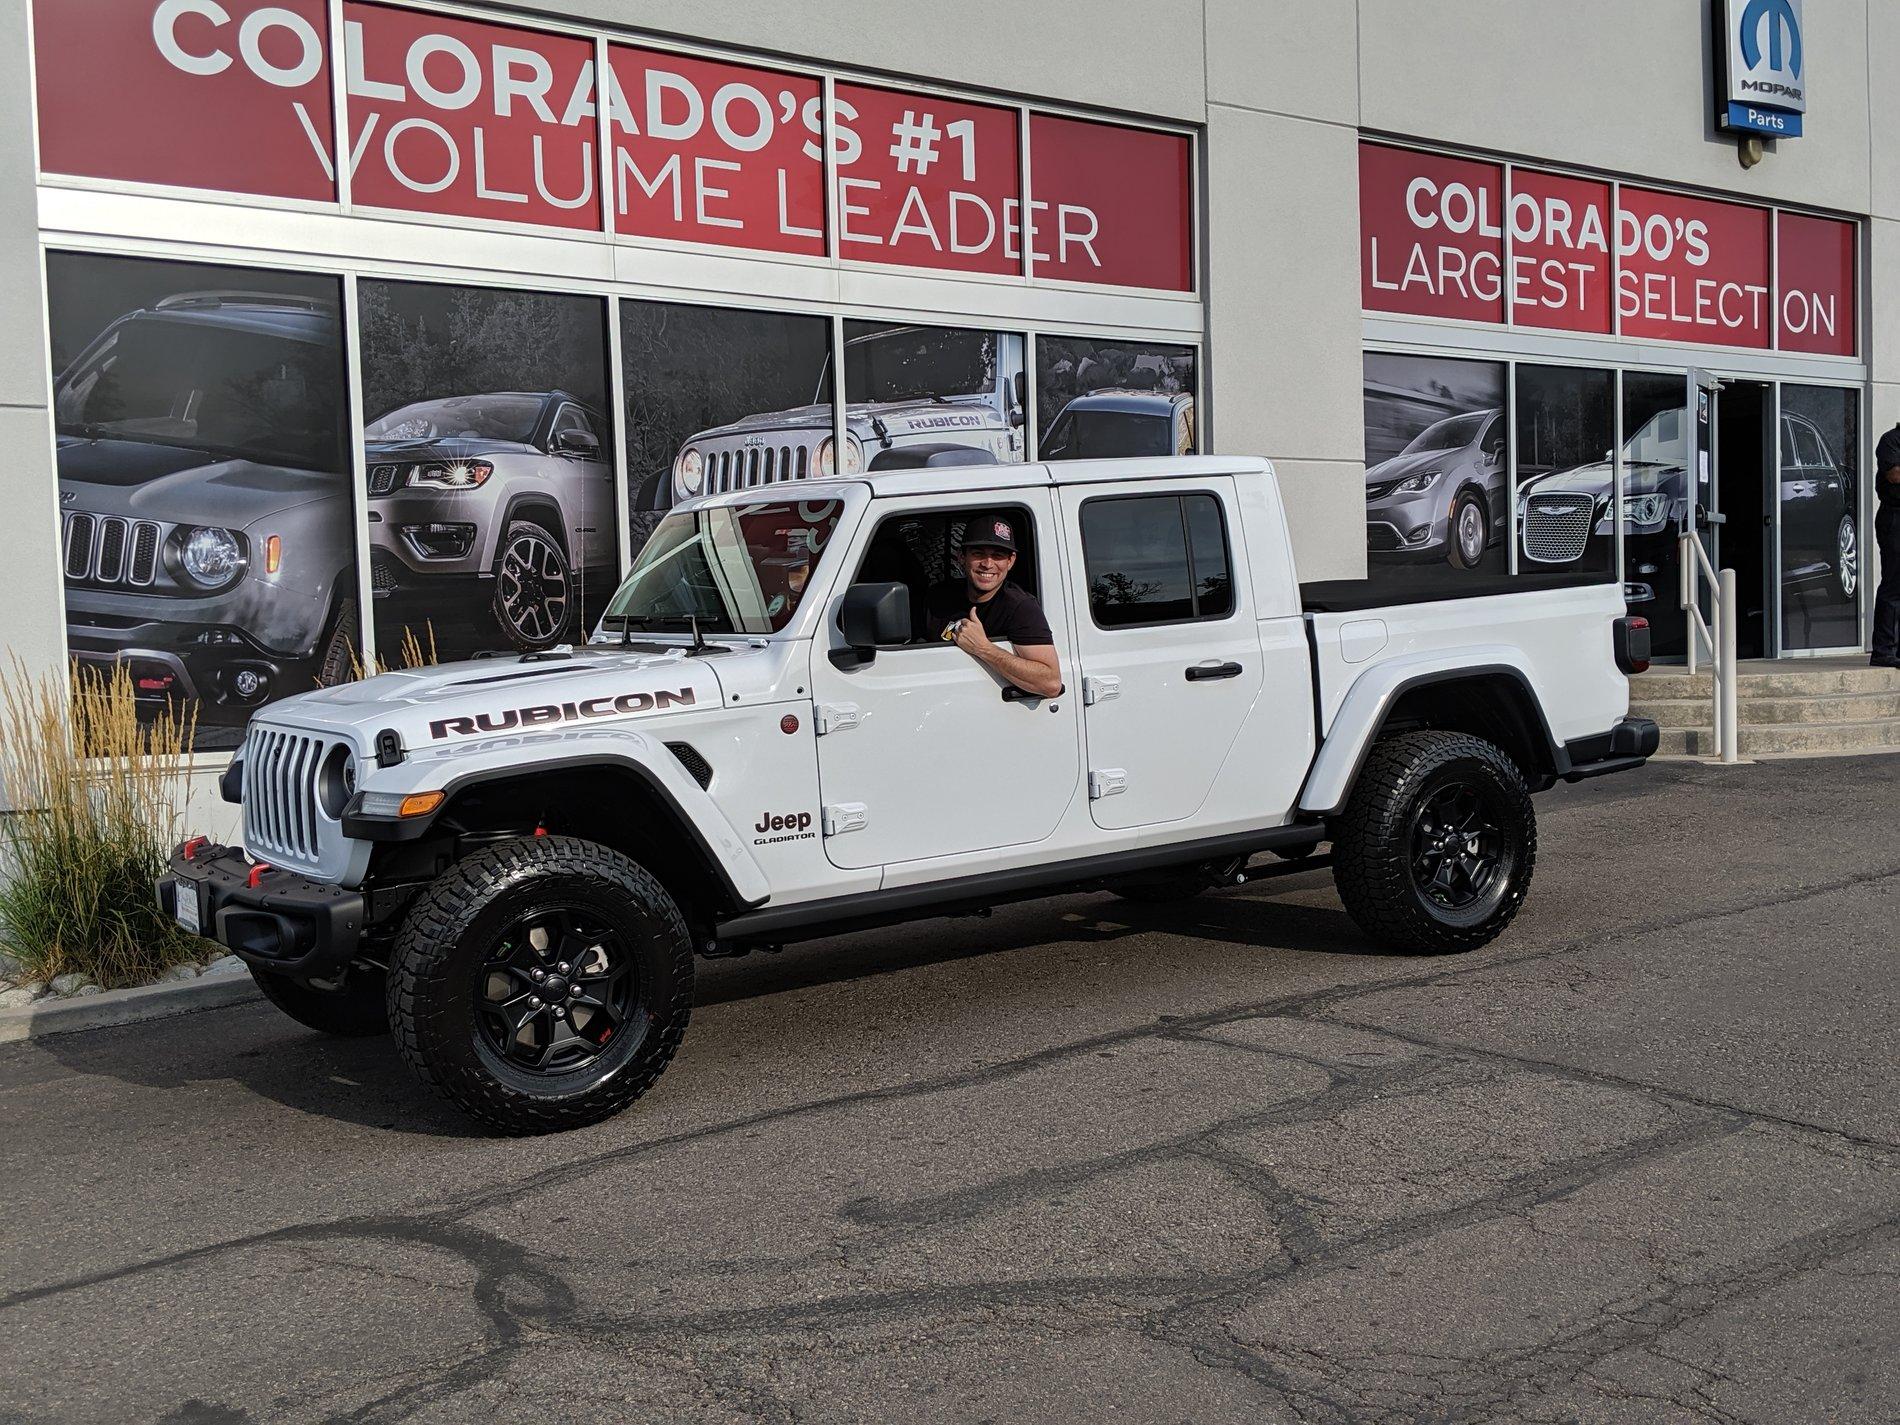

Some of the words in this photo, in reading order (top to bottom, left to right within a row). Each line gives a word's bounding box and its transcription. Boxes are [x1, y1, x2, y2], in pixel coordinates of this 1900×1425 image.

[153, 0, 863, 165] COLORADO'S
[890, 110, 976, 182] #1
[1741, 79, 1803, 101] MOPAR
[1748, 108, 1784, 129] Parts
[292, 102, 744, 229] VOLUME
[777, 169, 1102, 267] LEADER
[1406, 176, 1710, 266] COLORADO'S
[1371, 236, 1596, 311] LARGEST
[1618, 269, 1835, 337] SELECTON
[907, 414, 982, 429] RUBICON
[429, 686, 696, 740] RUBICON
[754, 832, 816, 845] GLADIATOR
[755, 812, 812, 833] Jeep
